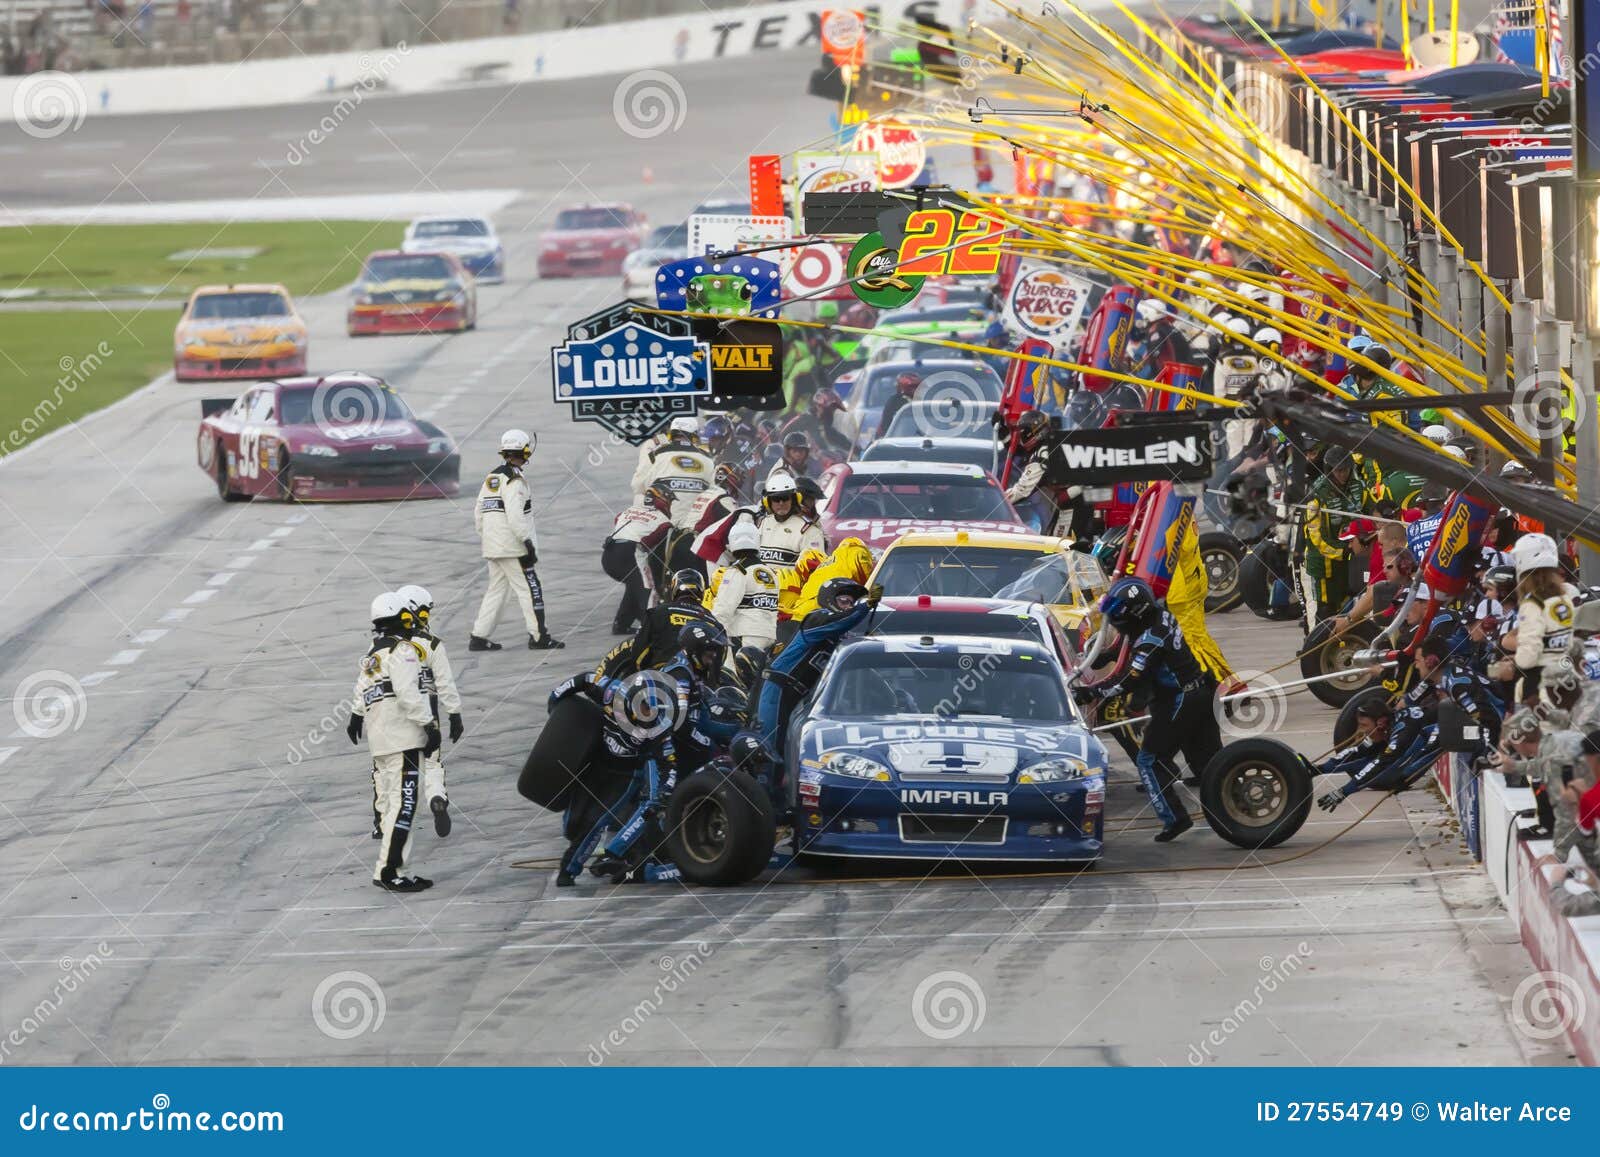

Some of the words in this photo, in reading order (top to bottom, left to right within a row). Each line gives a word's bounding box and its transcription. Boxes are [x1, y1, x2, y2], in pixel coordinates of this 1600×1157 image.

[711, 1, 939, 58] TEXS
[894, 207, 1008, 276] 22
[1022, 283, 1077, 299] BURGER
[1015, 298, 1076, 316] KING
[589, 311, 671, 335] TEAM
[572, 351, 693, 389] LOWE'S
[711, 347, 773, 368] WALT
[582, 398, 685, 413] RACING
[238, 425, 259, 479] 93
[1060, 435, 1197, 469] WHELEN
[834, 518, 1028, 535] Quicken
[1439, 503, 1470, 568] SUNOCO
[844, 723, 1059, 750] LOWE'S
[402, 779, 416, 816] Sprint
[900, 788, 1010, 806] IMPALA
